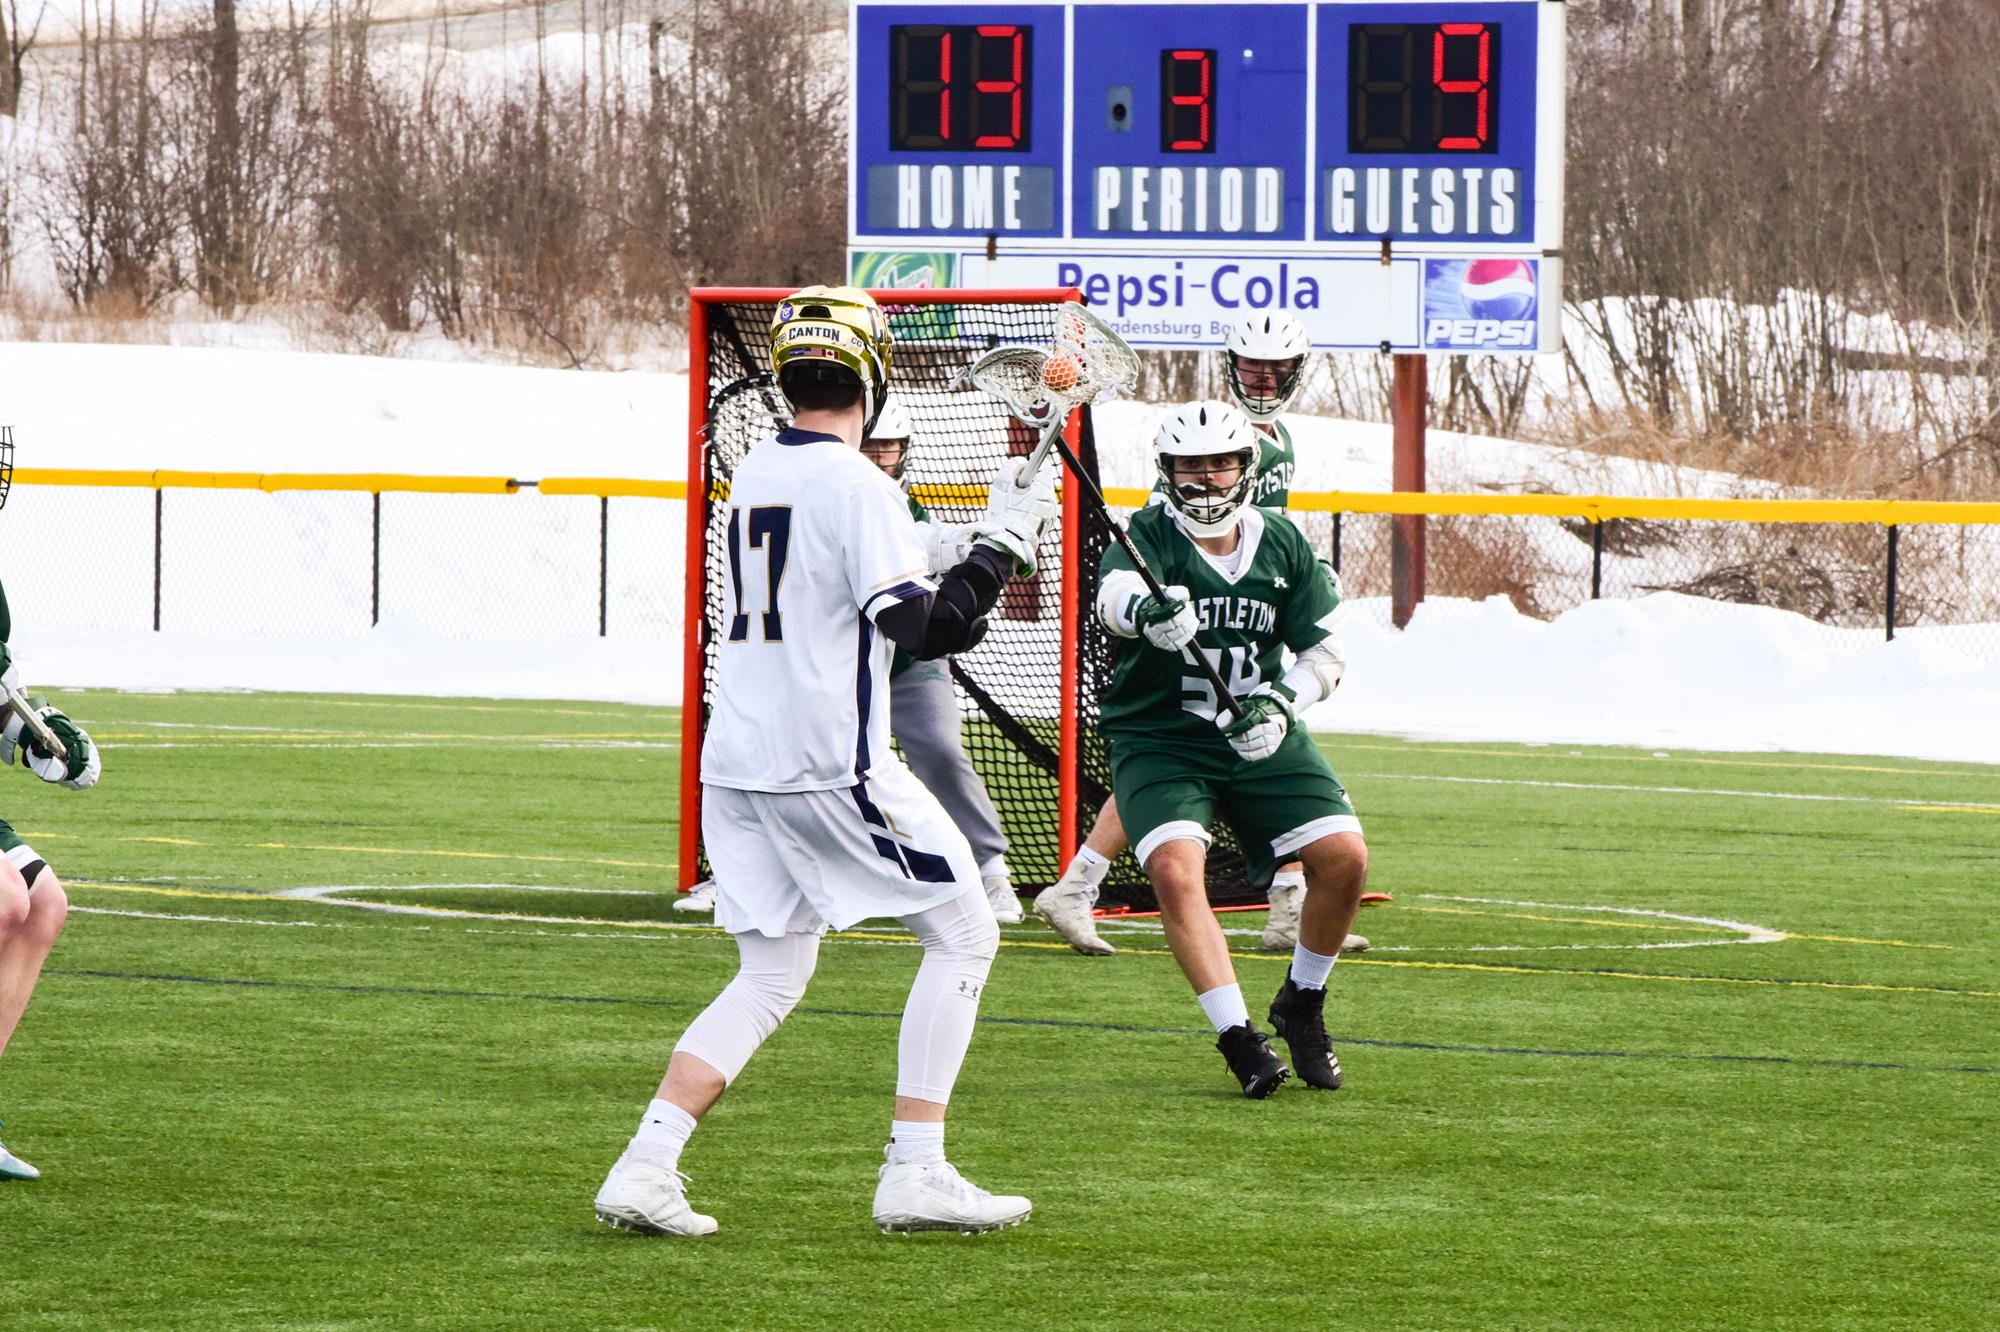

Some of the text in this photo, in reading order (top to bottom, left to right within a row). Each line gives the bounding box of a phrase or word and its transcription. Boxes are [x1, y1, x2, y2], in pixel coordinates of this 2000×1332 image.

[941, 25, 1023, 147] 13
[1172, 50, 1209, 150] 3
[1433, 23, 1490, 150] 9
[897, 164, 1022, 230] HOME
[1097, 166, 1281, 233] PERIOD
[1331, 166, 1516, 234] GUESTS
[1058, 261, 1320, 318] Pepsi-Cola
[788, 326, 840, 342] CANTON
[1103, 319, 1202, 338] gdensburg
[1425, 319, 1535, 346] PEPSI
[727, 503, 795, 644] 17
[1190, 596, 1277, 635] STLETON
